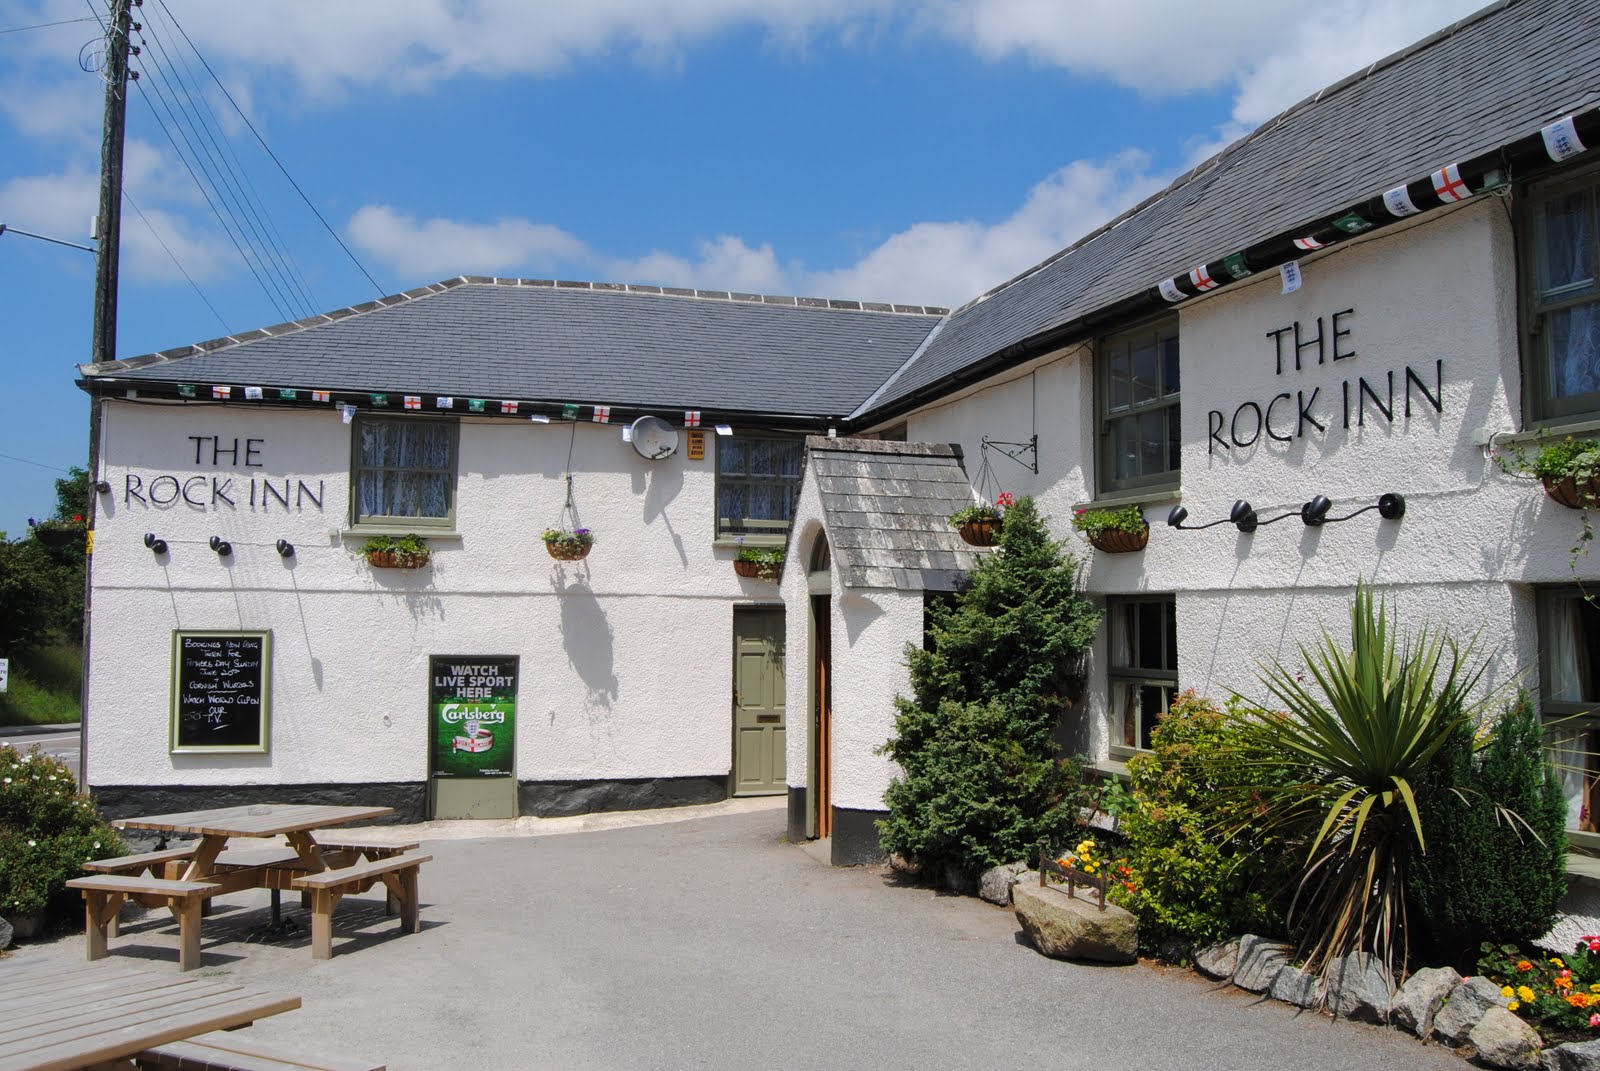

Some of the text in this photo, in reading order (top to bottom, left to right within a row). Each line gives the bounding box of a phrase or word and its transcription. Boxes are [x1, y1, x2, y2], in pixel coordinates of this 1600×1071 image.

[1266, 308, 1356, 376] THE
[1208, 359, 1443, 455] ROCK INN
[188, 435, 265, 467] THE
[124, 474, 324, 509] ROCK INN
[214, 660, 230, 669] DAY
[450, 665, 499, 676] WATCH
[435, 676, 514, 687] LIVE SPORT
[456, 687, 492, 698] HERE
[441, 703, 505, 724] Carlsberg
